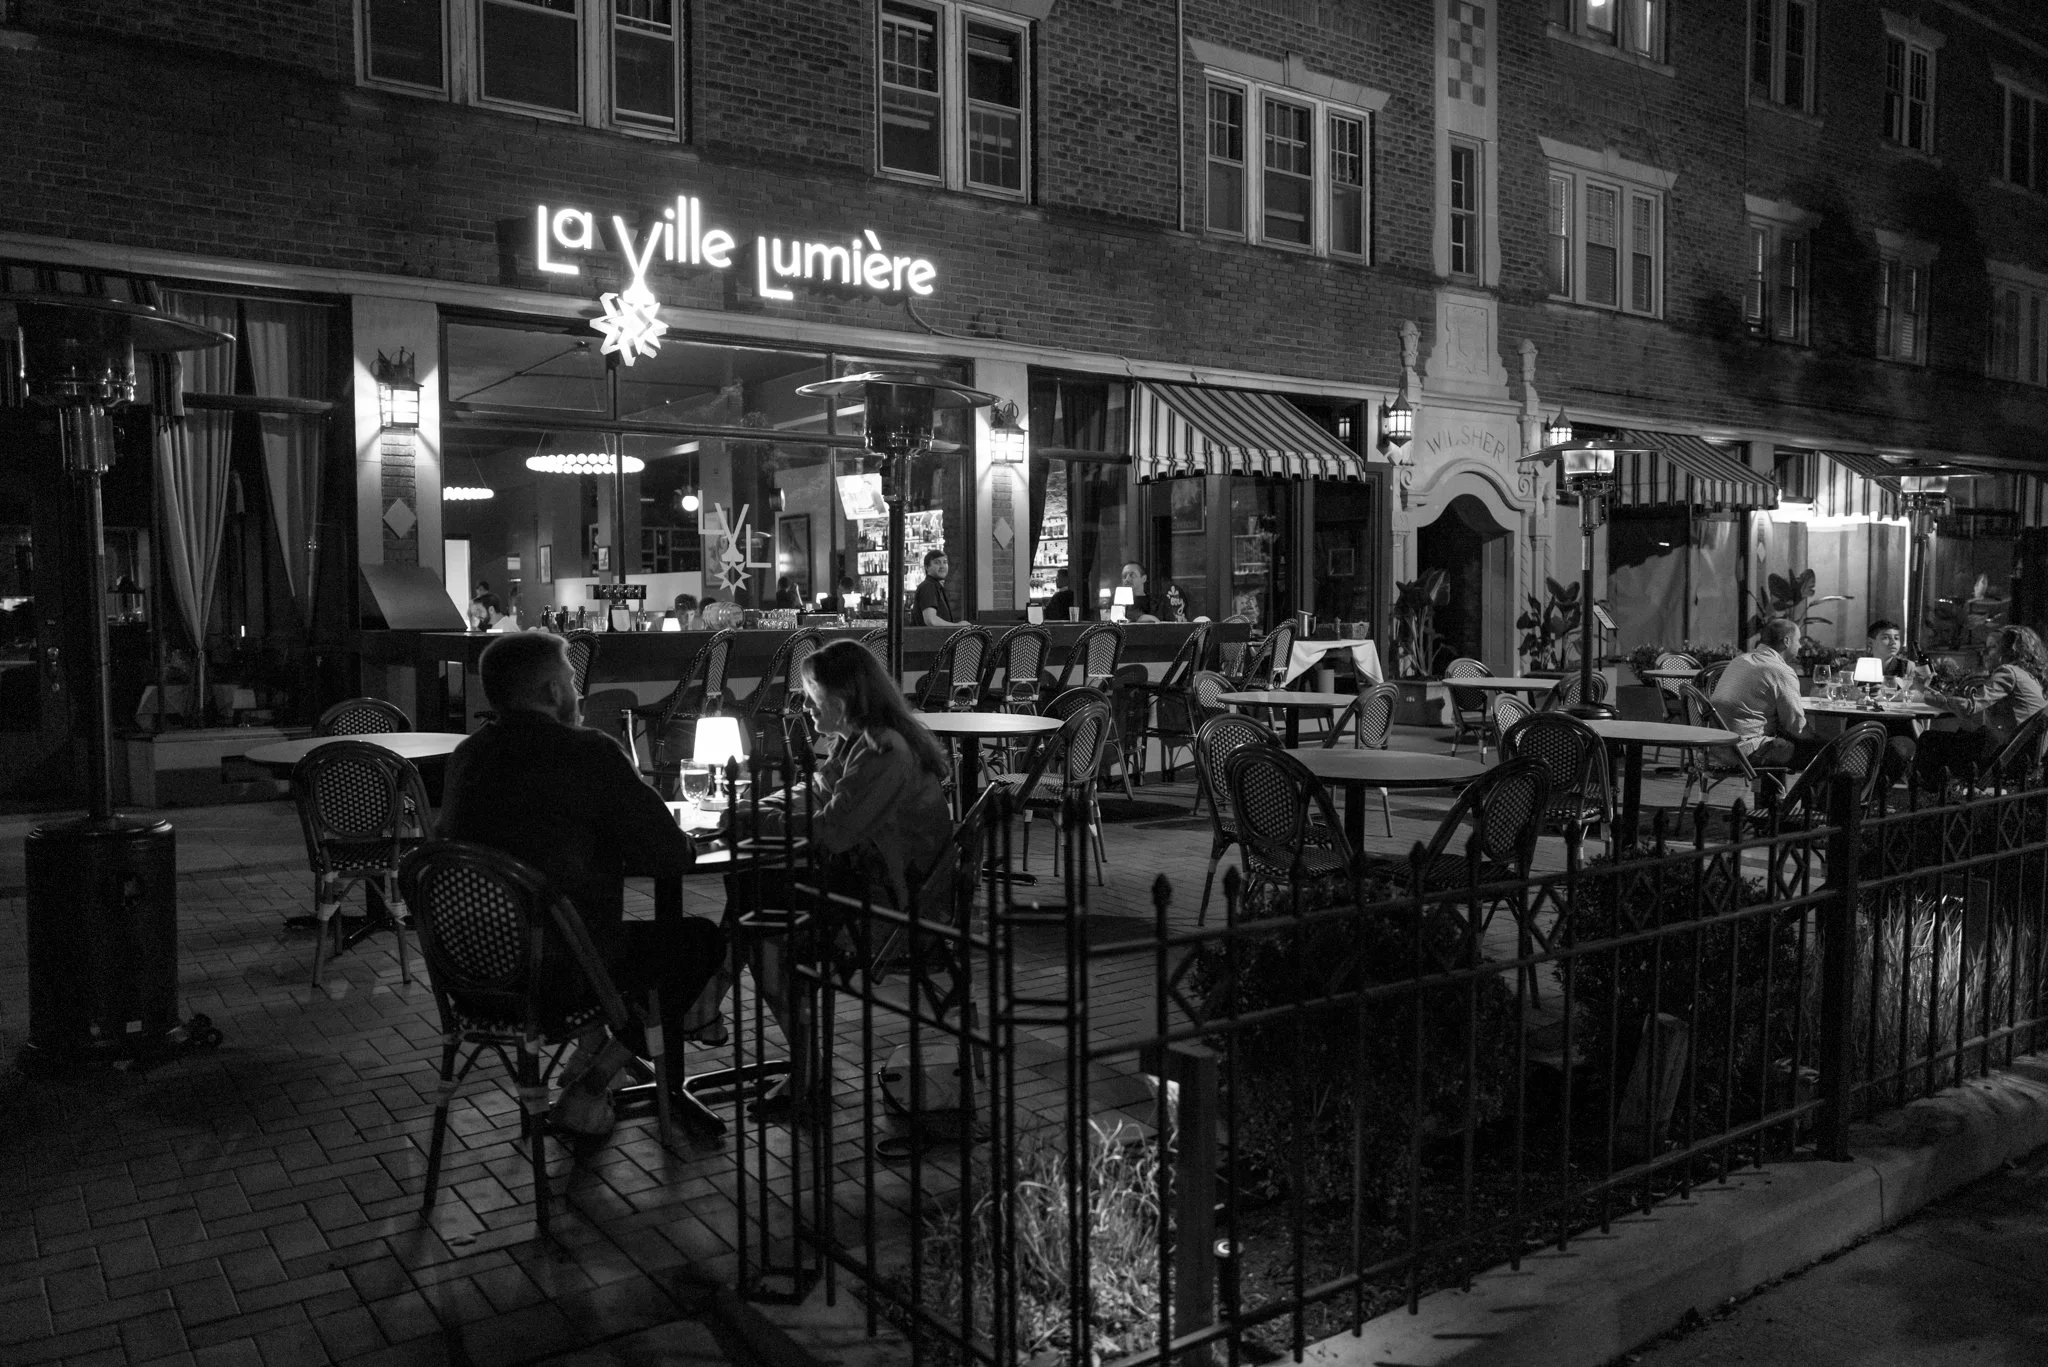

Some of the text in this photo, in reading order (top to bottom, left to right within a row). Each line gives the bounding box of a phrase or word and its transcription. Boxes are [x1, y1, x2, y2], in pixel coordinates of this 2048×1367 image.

[537, 195, 937, 303] La Ville Lumière
